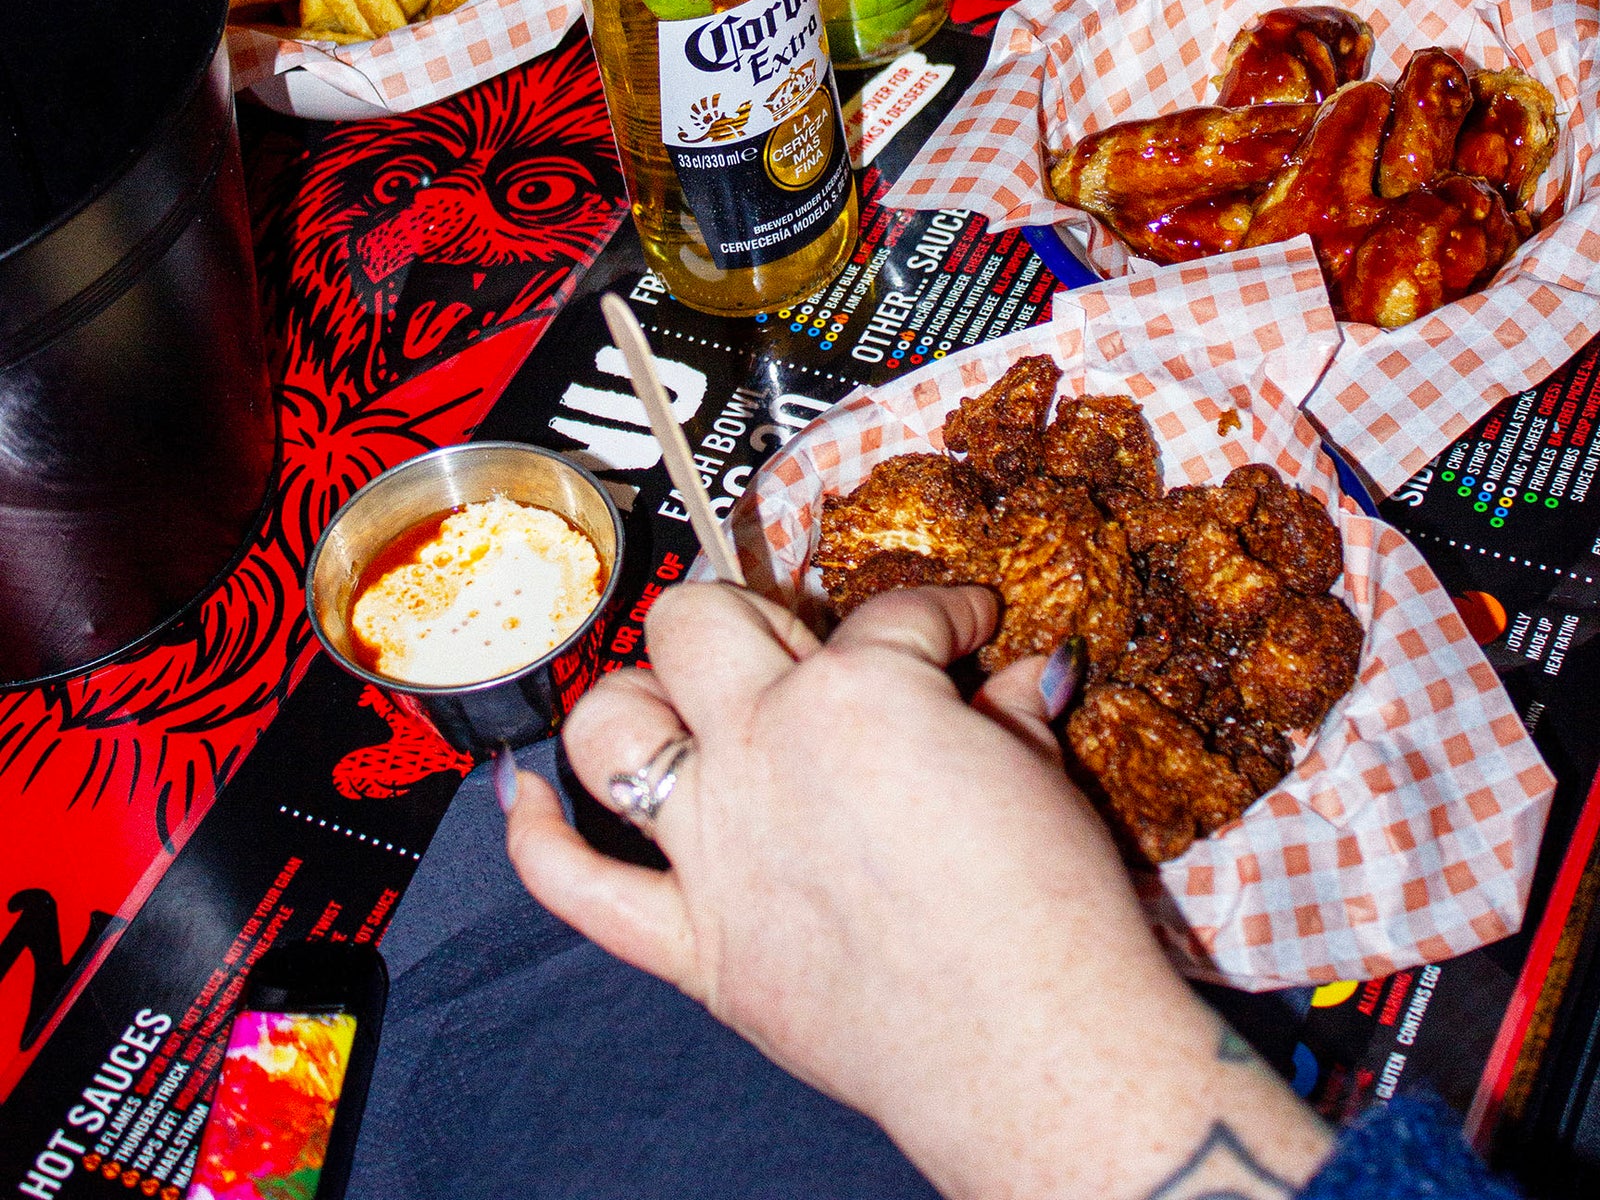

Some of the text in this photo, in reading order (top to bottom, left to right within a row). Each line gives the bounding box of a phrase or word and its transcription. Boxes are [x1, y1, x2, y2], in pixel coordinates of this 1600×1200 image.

[748, 14, 817, 86] Extra
[862, 86, 895, 111] OVER
[888, 67, 912, 87] FOR
[879, 118, 892, 127] &
[886, 71, 940, 119] DESSERTS
[772, 109, 828, 162] CERVEZA
[793, 114, 811, 134] LA
[793, 135, 821, 165] MAS
[795, 149, 824, 179] FINA
[720, 228, 791, 254] CERVECERÍA
[793, 202, 832, 235] MODELO,
[754, 214, 794, 235] BREWED
[795, 193, 822, 216] UNDER
[821, 165, 843, 197] LICENCE
[825, 285, 848, 309] BABY
[844, 264, 861, 288] BLUE
[845, 292, 861, 310] AM
[855, 248, 891, 296] SPARTACUS
[910, 215, 987, 331] NACHO WINGS CHEESE SAUCE
[927, 240, 990, 337] FACON BURGER CHEESE
[949, 306, 972, 341] ROYALE
[964, 284, 983, 314] WITH
[979, 255, 1003, 288] CHEESE
[963, 240, 1031, 345] BUMBLEBEE ALL-PURPOSE
[851, 278, 929, 363] OTHER...
[998, 298, 1019, 327] BEEN
[1011, 281, 1028, 304] THE
[1019, 303, 1037, 326] BEE
[702, 385, 770, 455] BOWL
[1487, 390, 1537, 481] MOZZARELLA STICKS
[1528, 447, 1558, 492] FRICKLES
[1548, 402, 1578, 446] BATTERED
[1566, 369, 1590, 406] PICKLE
[1570, 418, 1592, 447] CRISP
[1446, 441, 1469, 471] CHIPS
[1466, 441, 1492, 476] STRIPS
[1507, 461, 1528, 486] MAC
[1522, 416, 1549, 451] CHEESE
[1563, 447, 1581, 473] RIBS
[1570, 470, 1593, 502] SAUCE
[1582, 455, 1598, 474] ON
[1549, 468, 1571, 498] CORN
[610, 626, 643, 654] OR
[655, 552, 685, 580] OF
[1505, 612, 1532, 652] TOTALLY
[1526, 617, 1554, 661] MADE UP
[1543, 614, 1580, 676] HEAT RATING
[1526, 700, 1546, 735] AWAY
[366, 888, 399, 926] SAUCE
[100, 1096, 142, 1147] FLAMES
[239, 915, 263, 943] FOR
[254, 887, 283, 923] YOUR
[274, 856, 304, 891] GRAN
[1396, 964, 1442, 1046] CONTAINS EGG
[113, 1061, 190, 1163] THUNDERSTRUCK
[245, 905, 295, 968] PINEAPPLE
[1376, 1051, 1407, 1100] GLUTEN
[18, 1008, 173, 1200] HOT SAUCES
[132, 1137, 163, 1172] TAPS
[155, 1110, 182, 1141] AFF!
[152, 1103, 210, 1181] MAELSTROM
